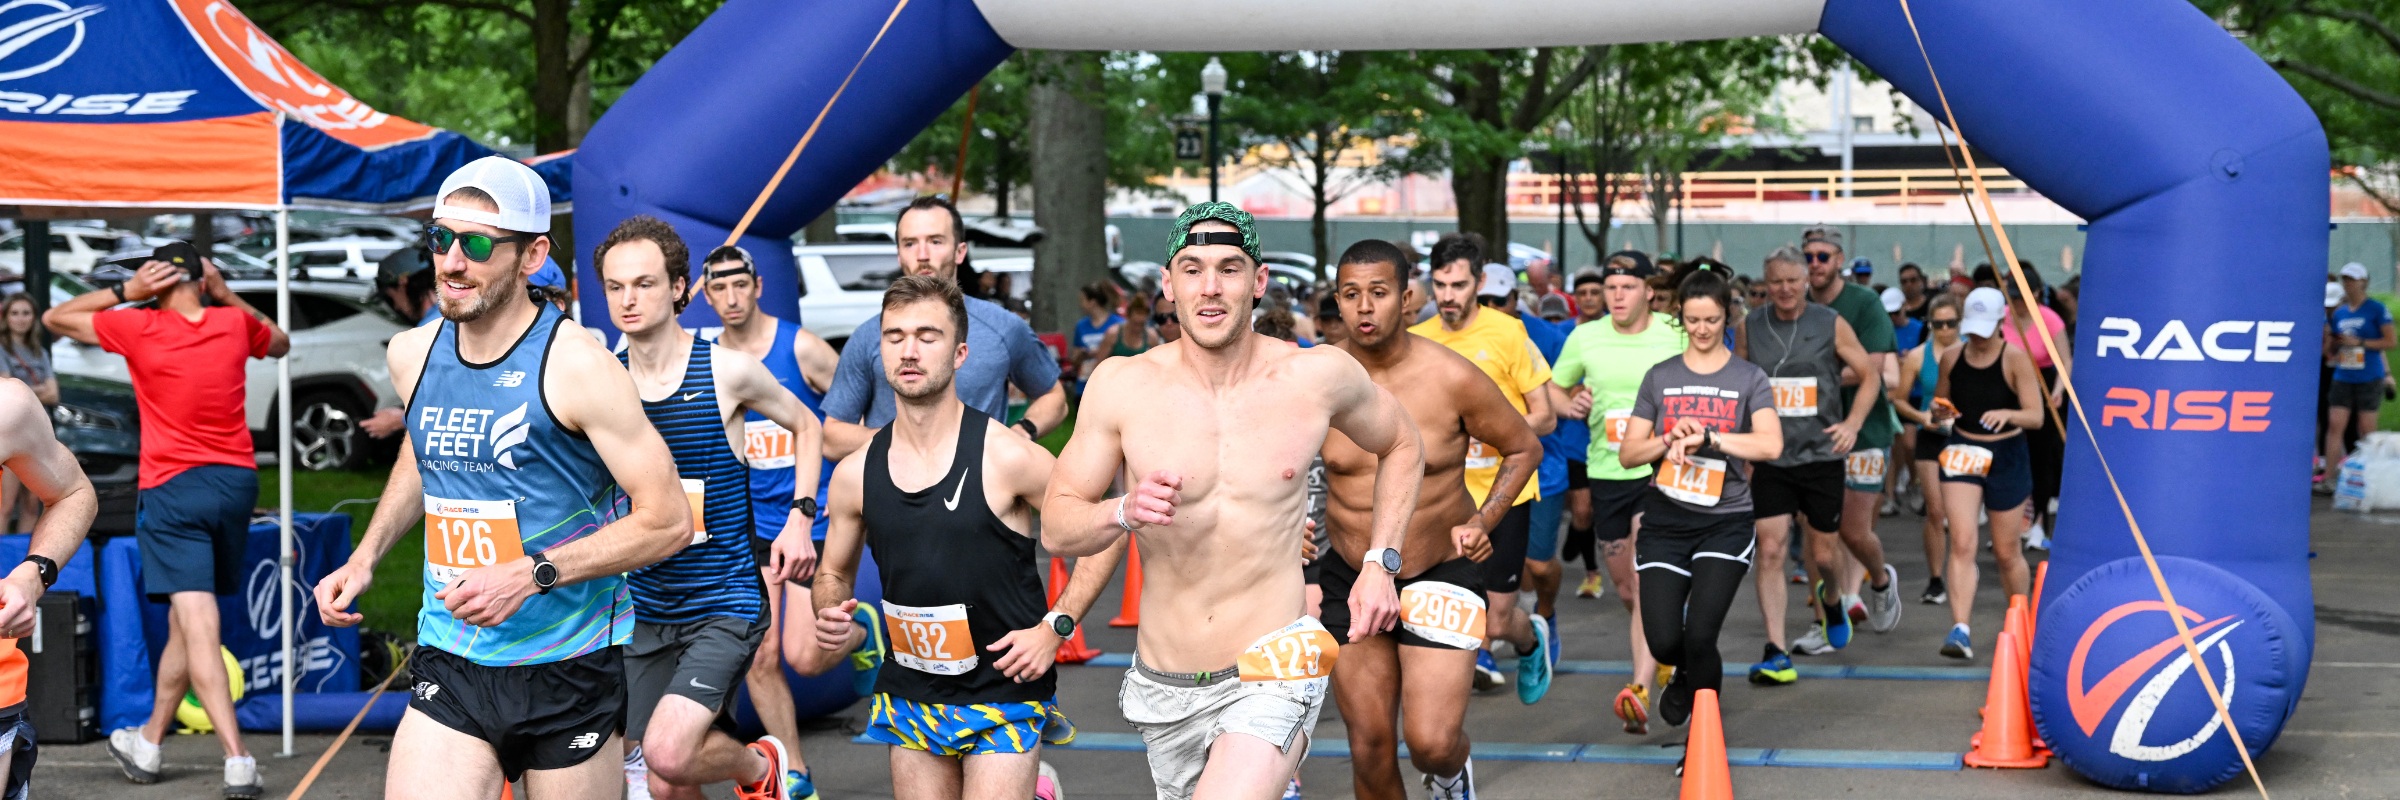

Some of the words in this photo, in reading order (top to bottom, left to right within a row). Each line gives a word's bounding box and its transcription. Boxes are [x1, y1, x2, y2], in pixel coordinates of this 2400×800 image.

[2097, 317, 2296, 362] RACE
[419, 406, 494, 433] FLEET
[1663, 396, 1738, 419] TEAM
[2102, 387, 2274, 432] RISE
[425, 432, 485, 458] FEET
[744, 430, 793, 459] 2977
[422, 459, 459, 472] RACING
[463, 461, 494, 473] TEAM
[1672, 464, 1709, 494] 144
[437, 518, 497, 567] 126
[1408, 591, 1479, 635] 2967
[898, 621, 952, 659] 132
[1261, 632, 1322, 679] 125
